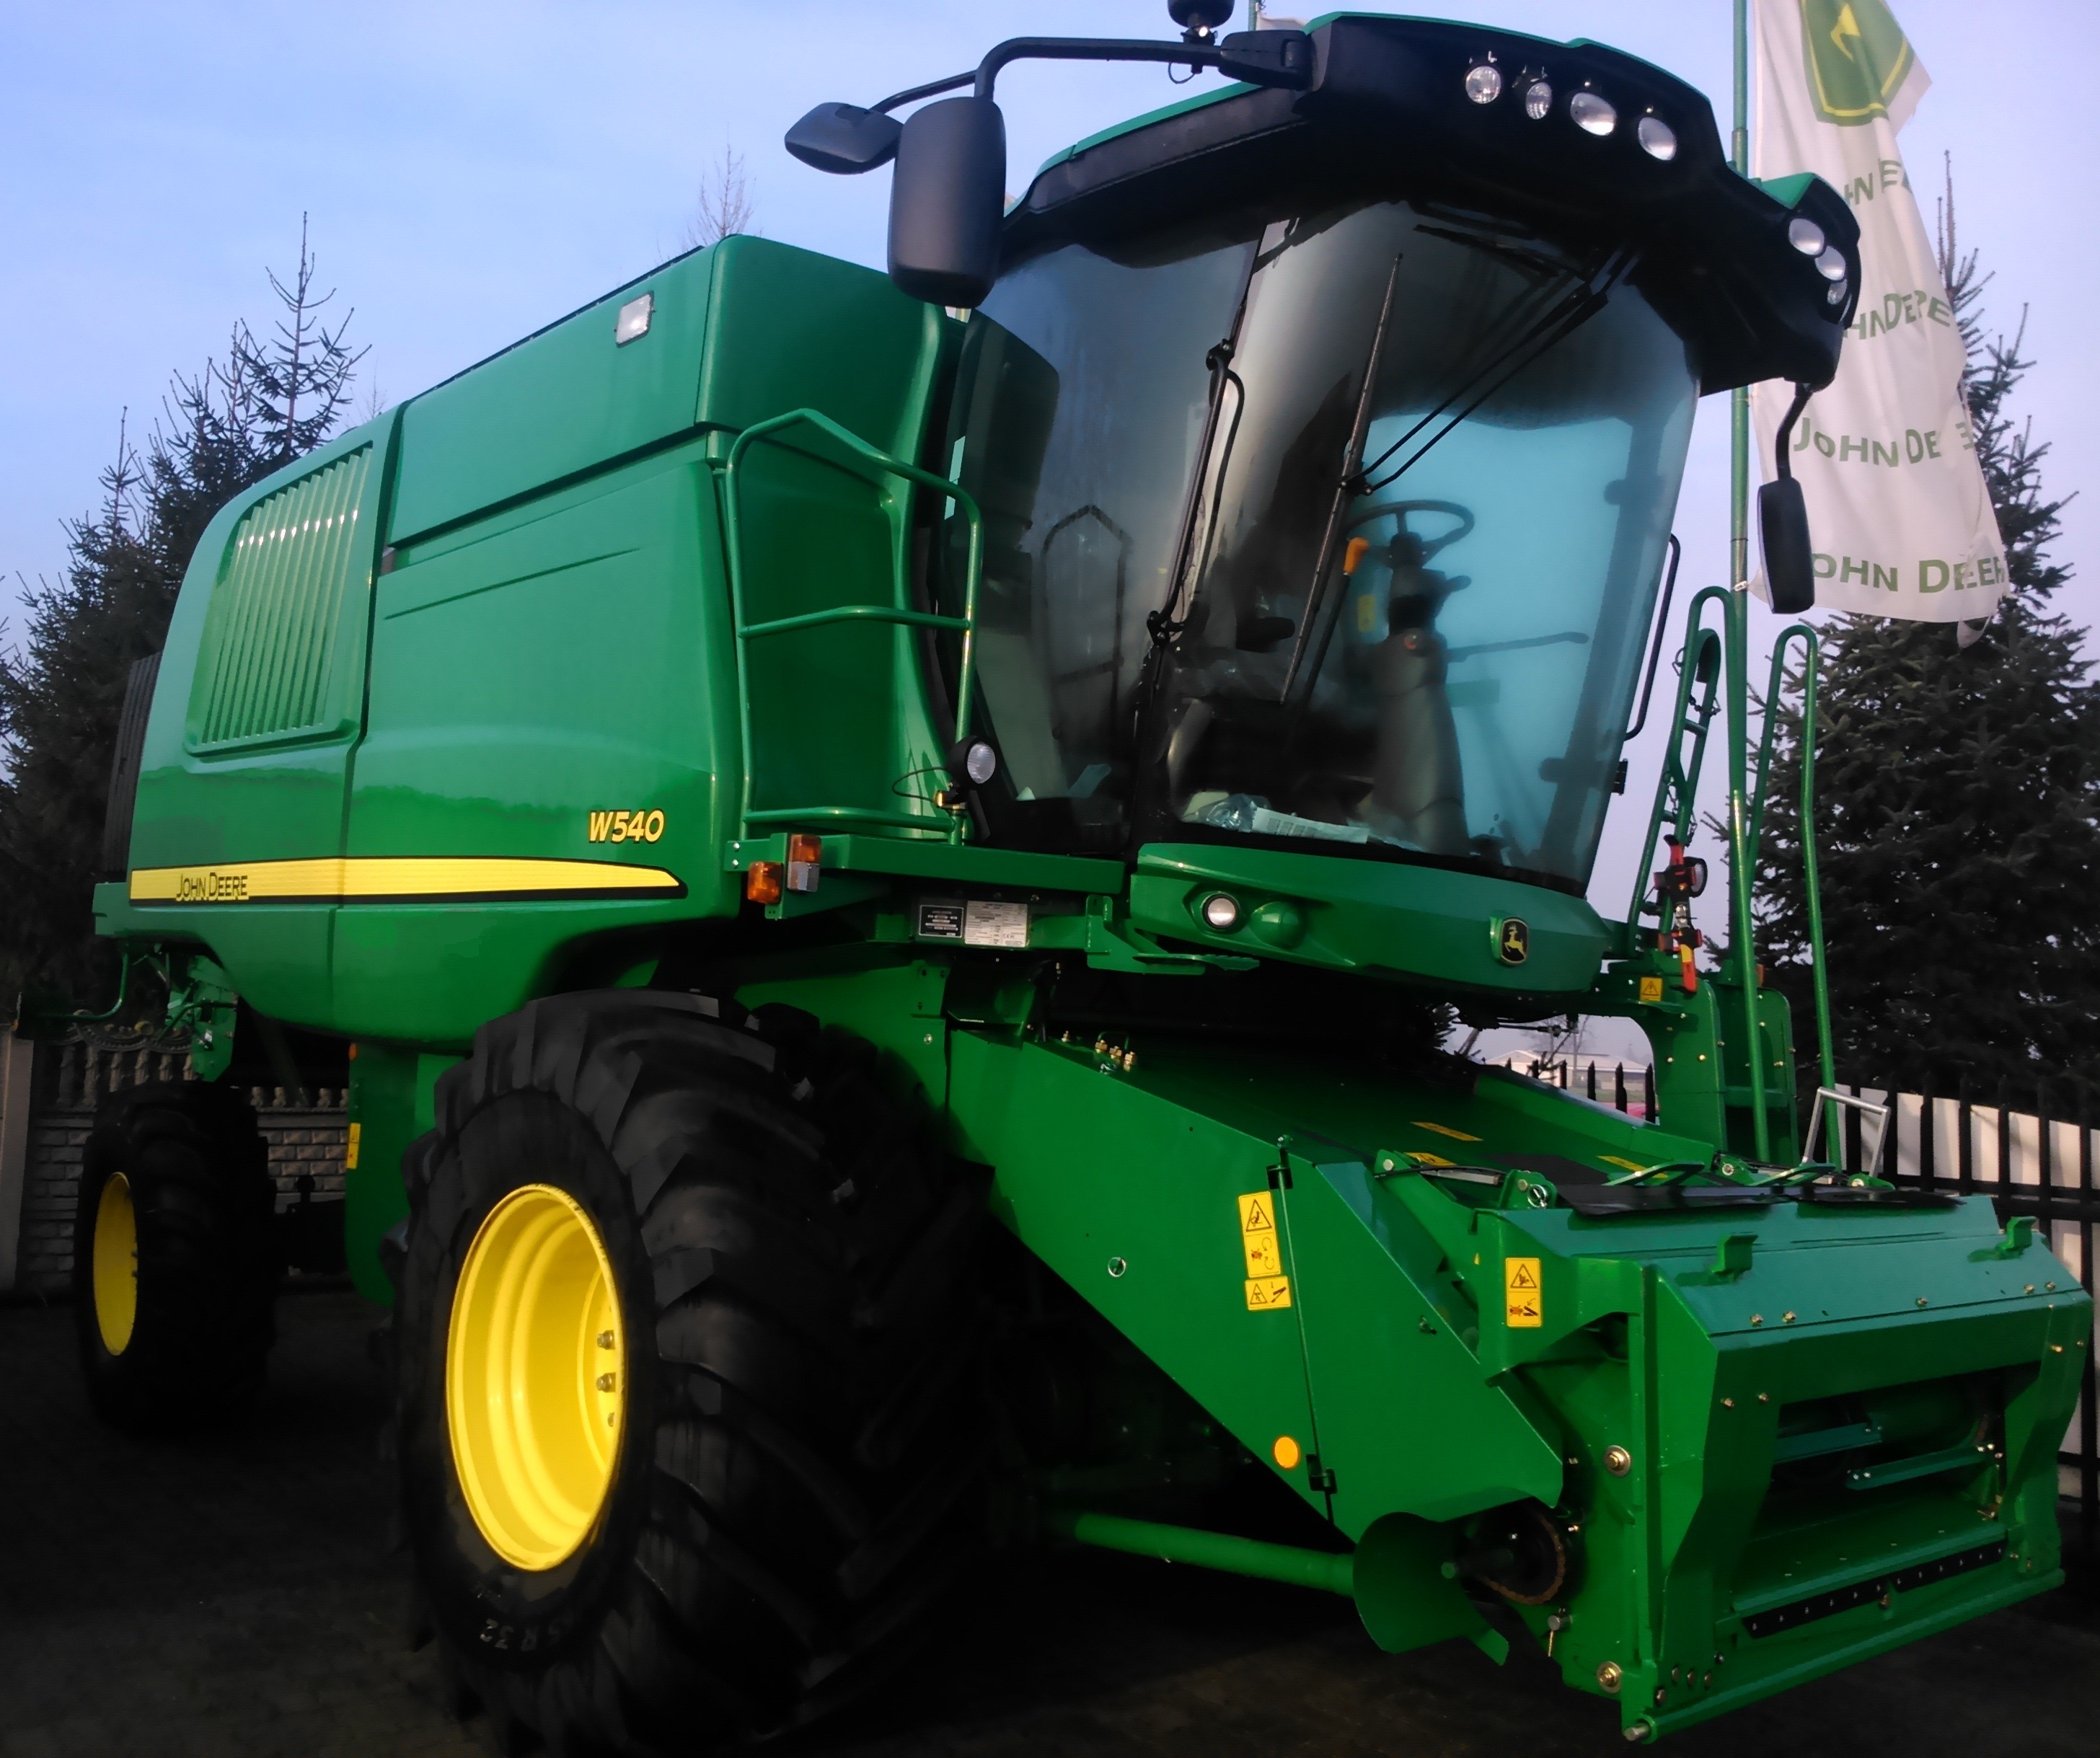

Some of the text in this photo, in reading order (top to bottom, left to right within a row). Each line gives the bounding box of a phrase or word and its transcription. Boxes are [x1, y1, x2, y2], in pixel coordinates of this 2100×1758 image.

[1843, 309, 1886, 340] HN
[1794, 417, 1899, 468] JOHN
[1812, 552, 2006, 593] OHN DEER
[589, 808, 664, 844] W540
[176, 872, 248, 899] JOHN DEERE
